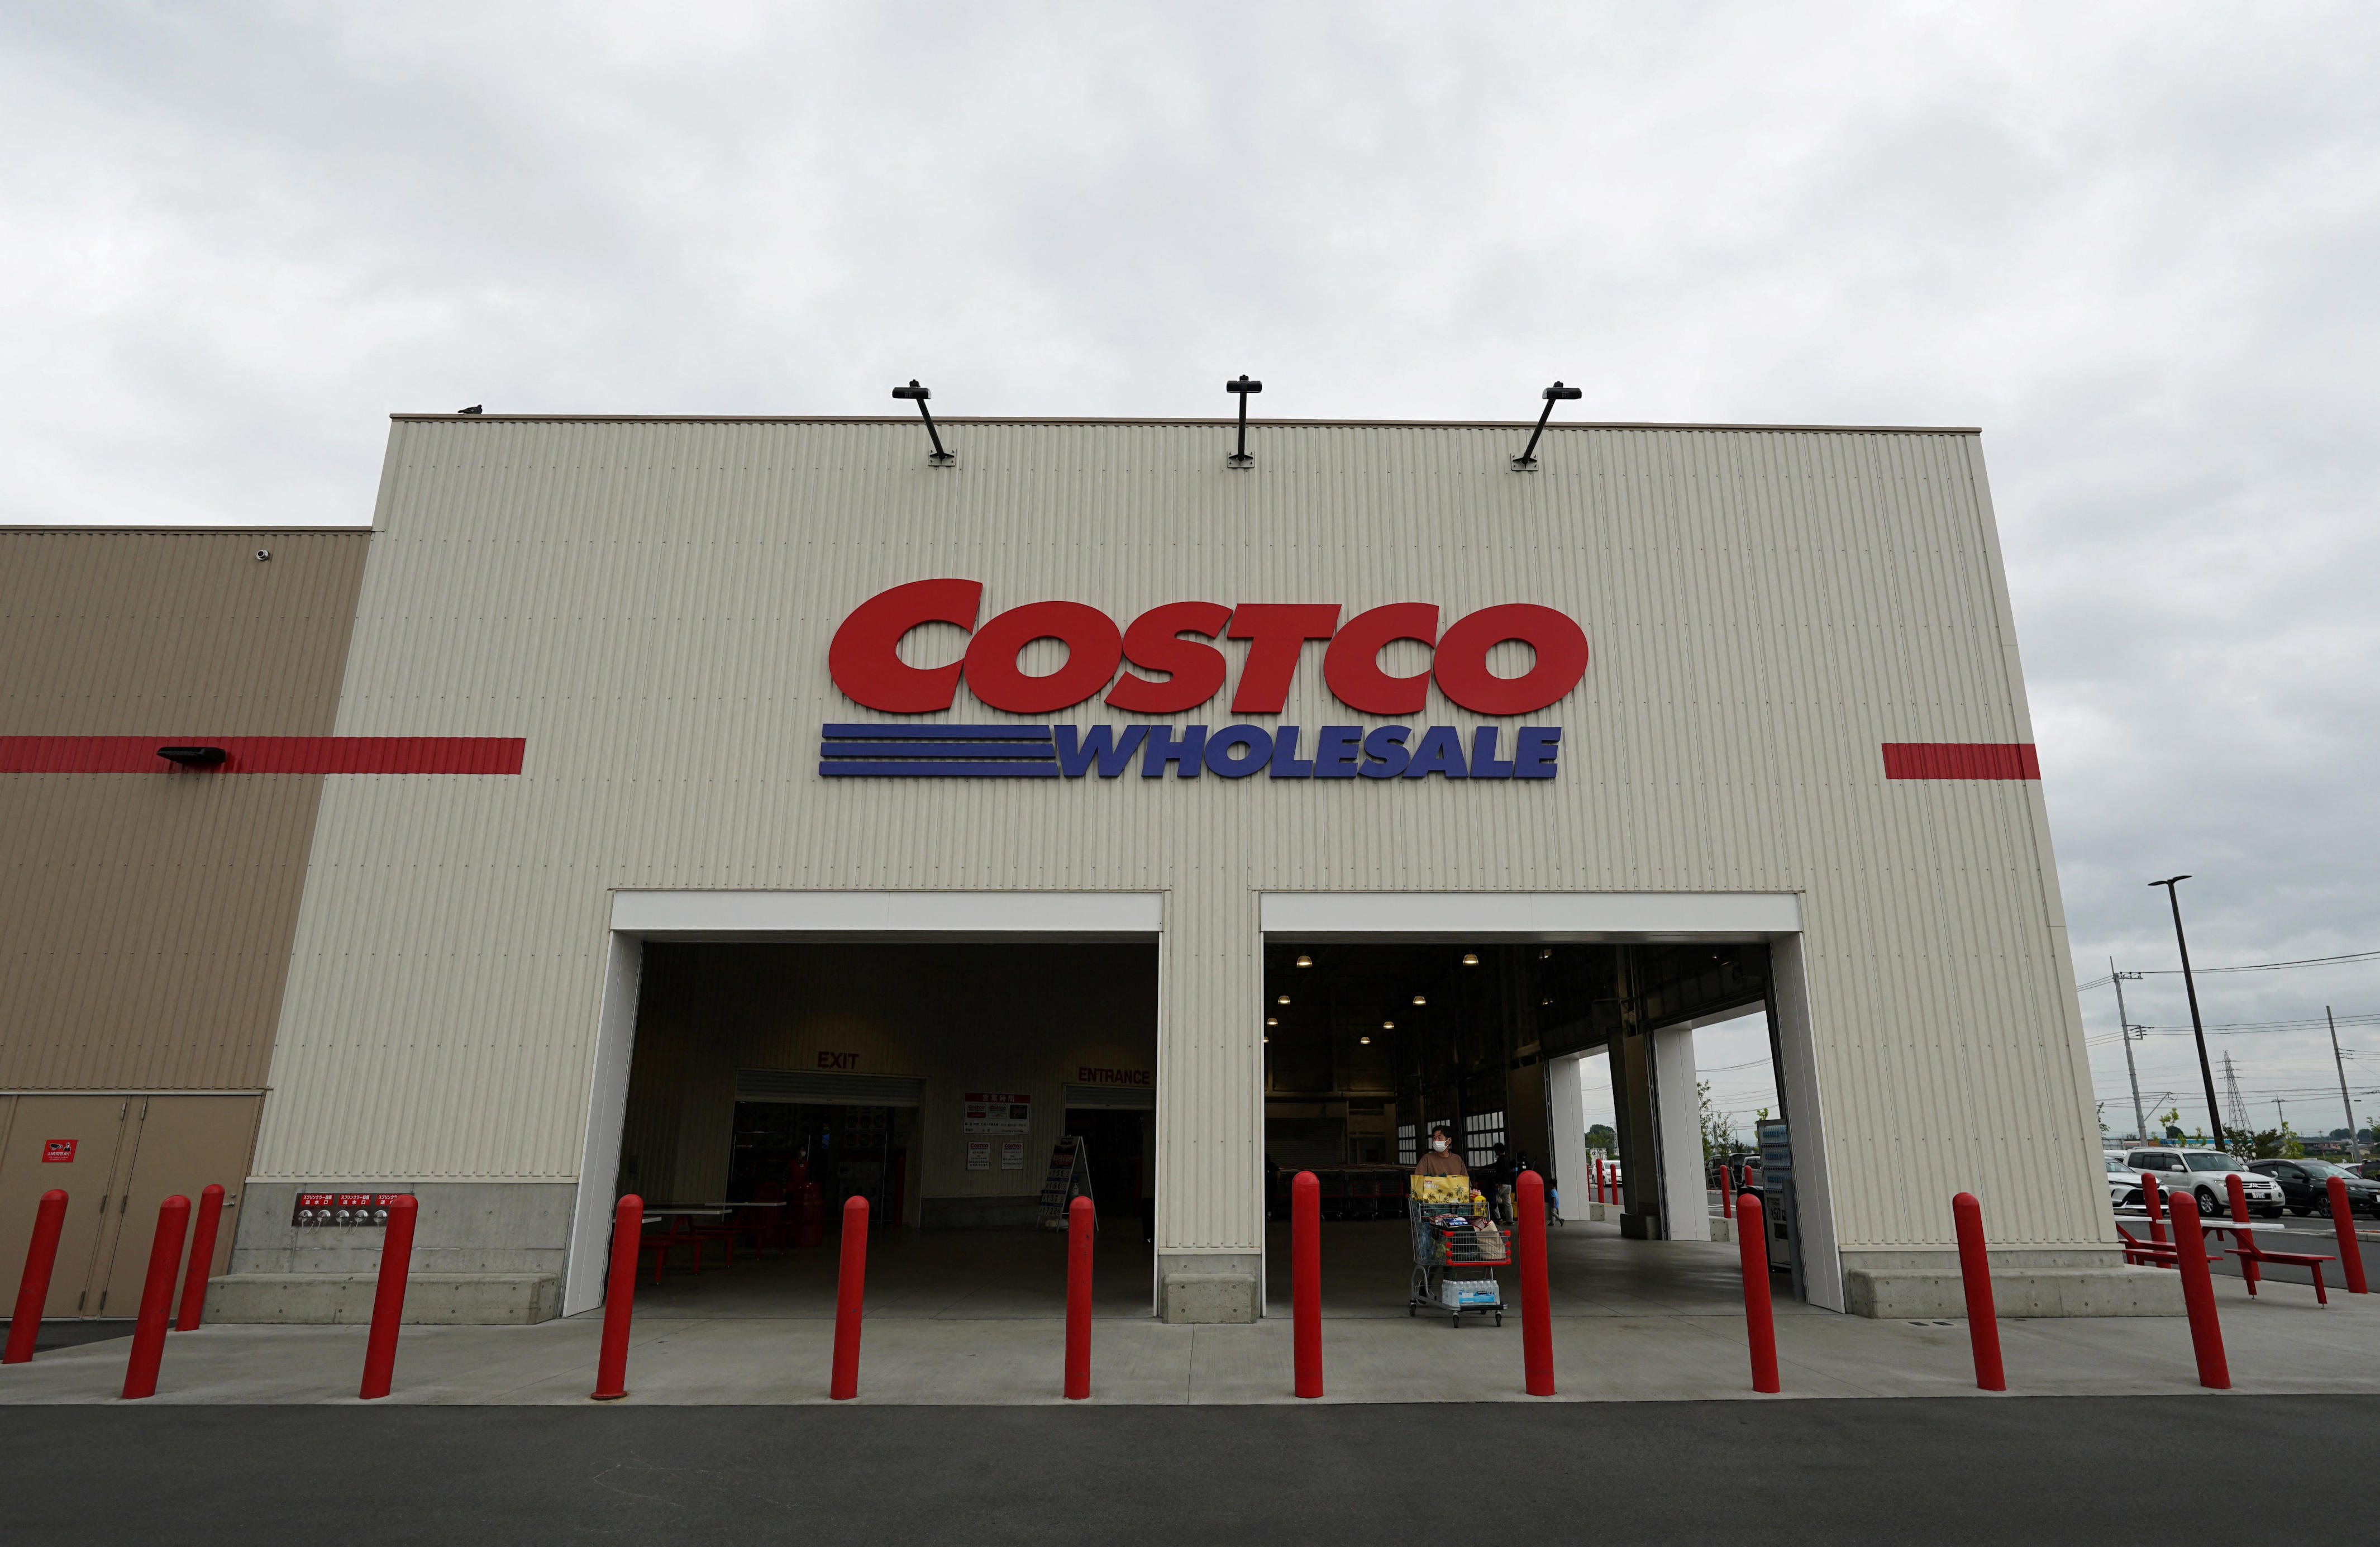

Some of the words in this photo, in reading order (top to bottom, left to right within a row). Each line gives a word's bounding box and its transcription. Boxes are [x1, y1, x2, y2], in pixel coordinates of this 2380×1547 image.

[828, 578, 1588, 715] COSTCO
[1053, 724, 1562, 779] WHOLESALE
[818, 1051, 859, 1069] EXIT
[1079, 1067, 1150, 1084] ENTRANCE
